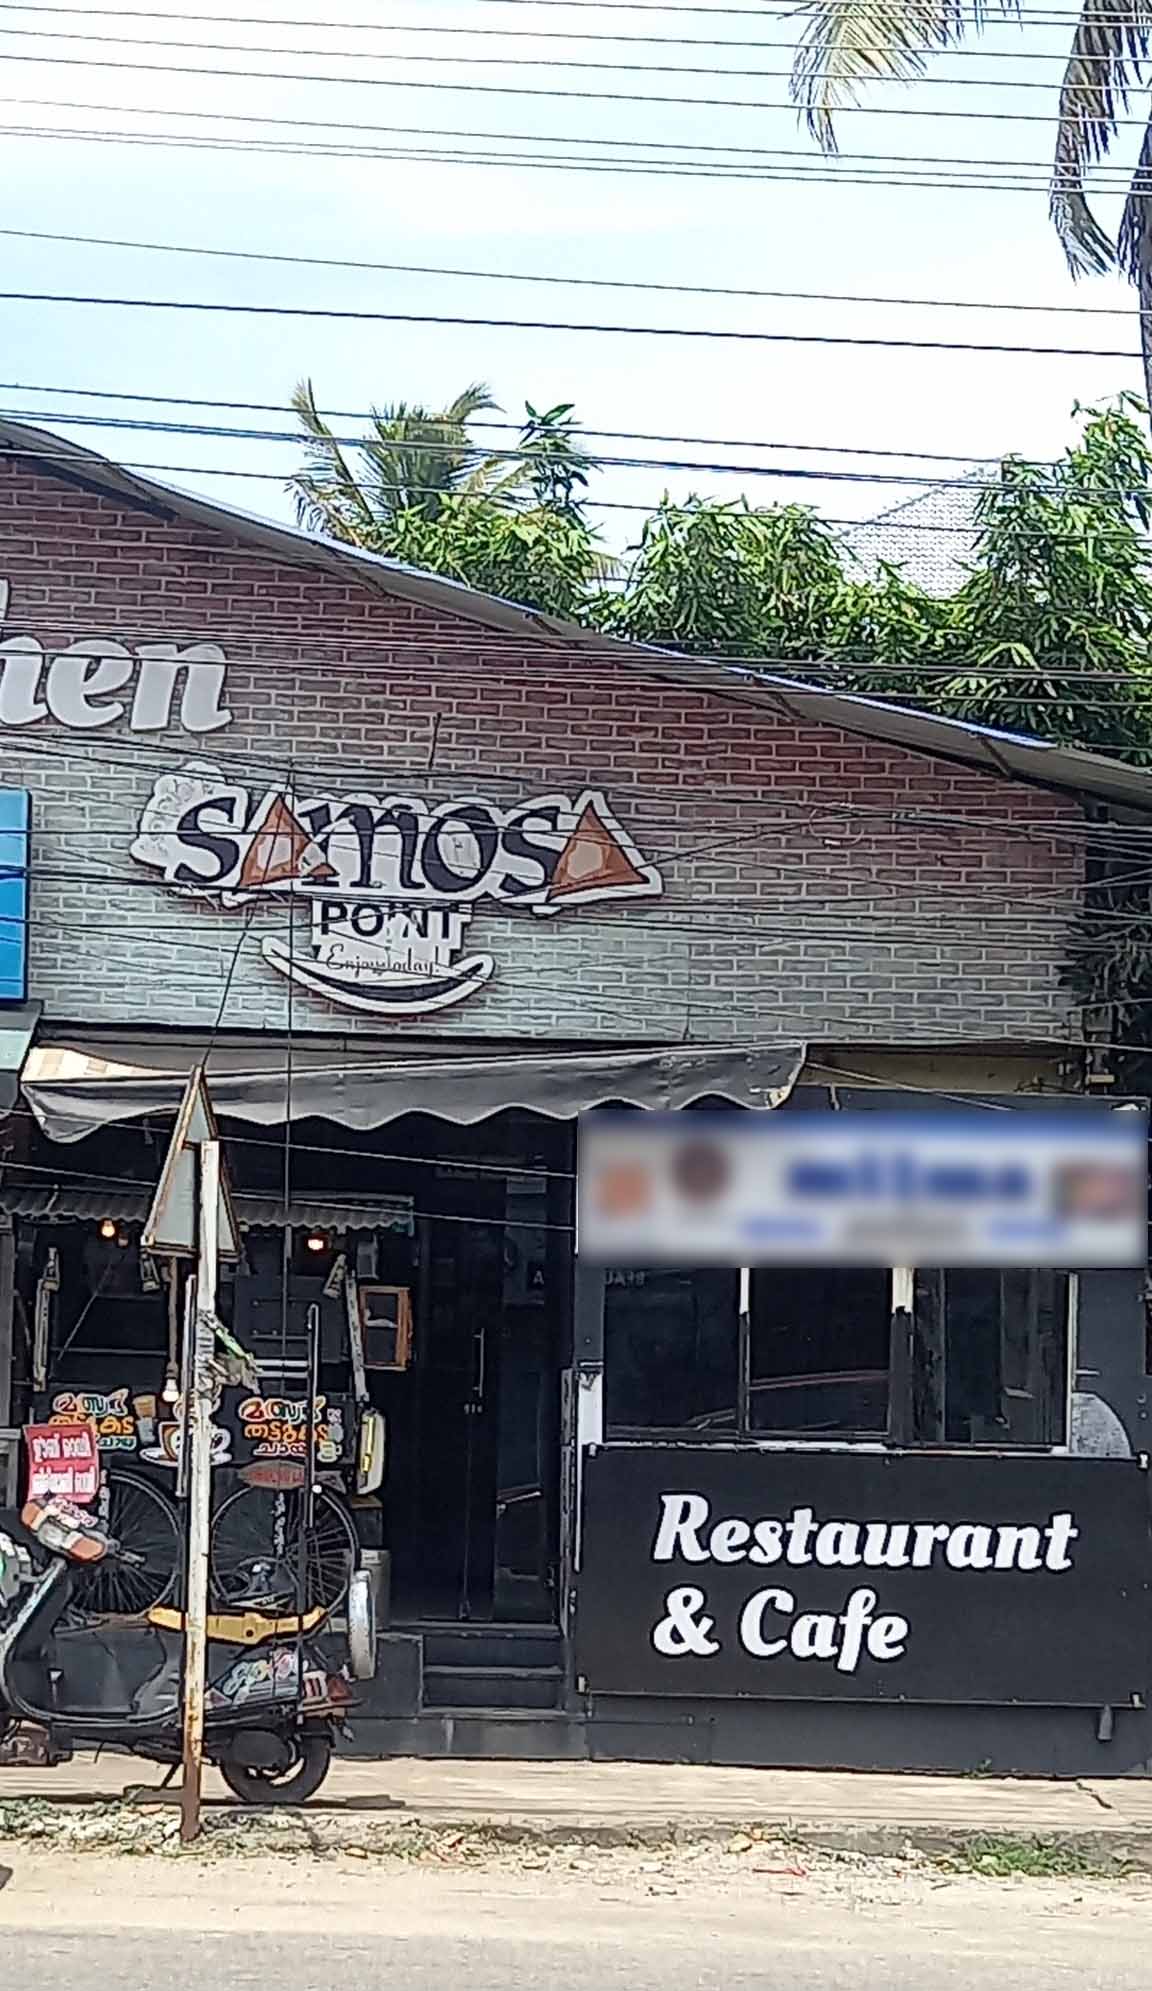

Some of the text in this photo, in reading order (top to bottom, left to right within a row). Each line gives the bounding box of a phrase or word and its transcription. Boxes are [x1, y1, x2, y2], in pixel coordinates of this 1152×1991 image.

[320, 901, 462, 940] POINT
[653, 1494, 1078, 1570] Restaurant
[653, 1587, 910, 1672] & Cafe
